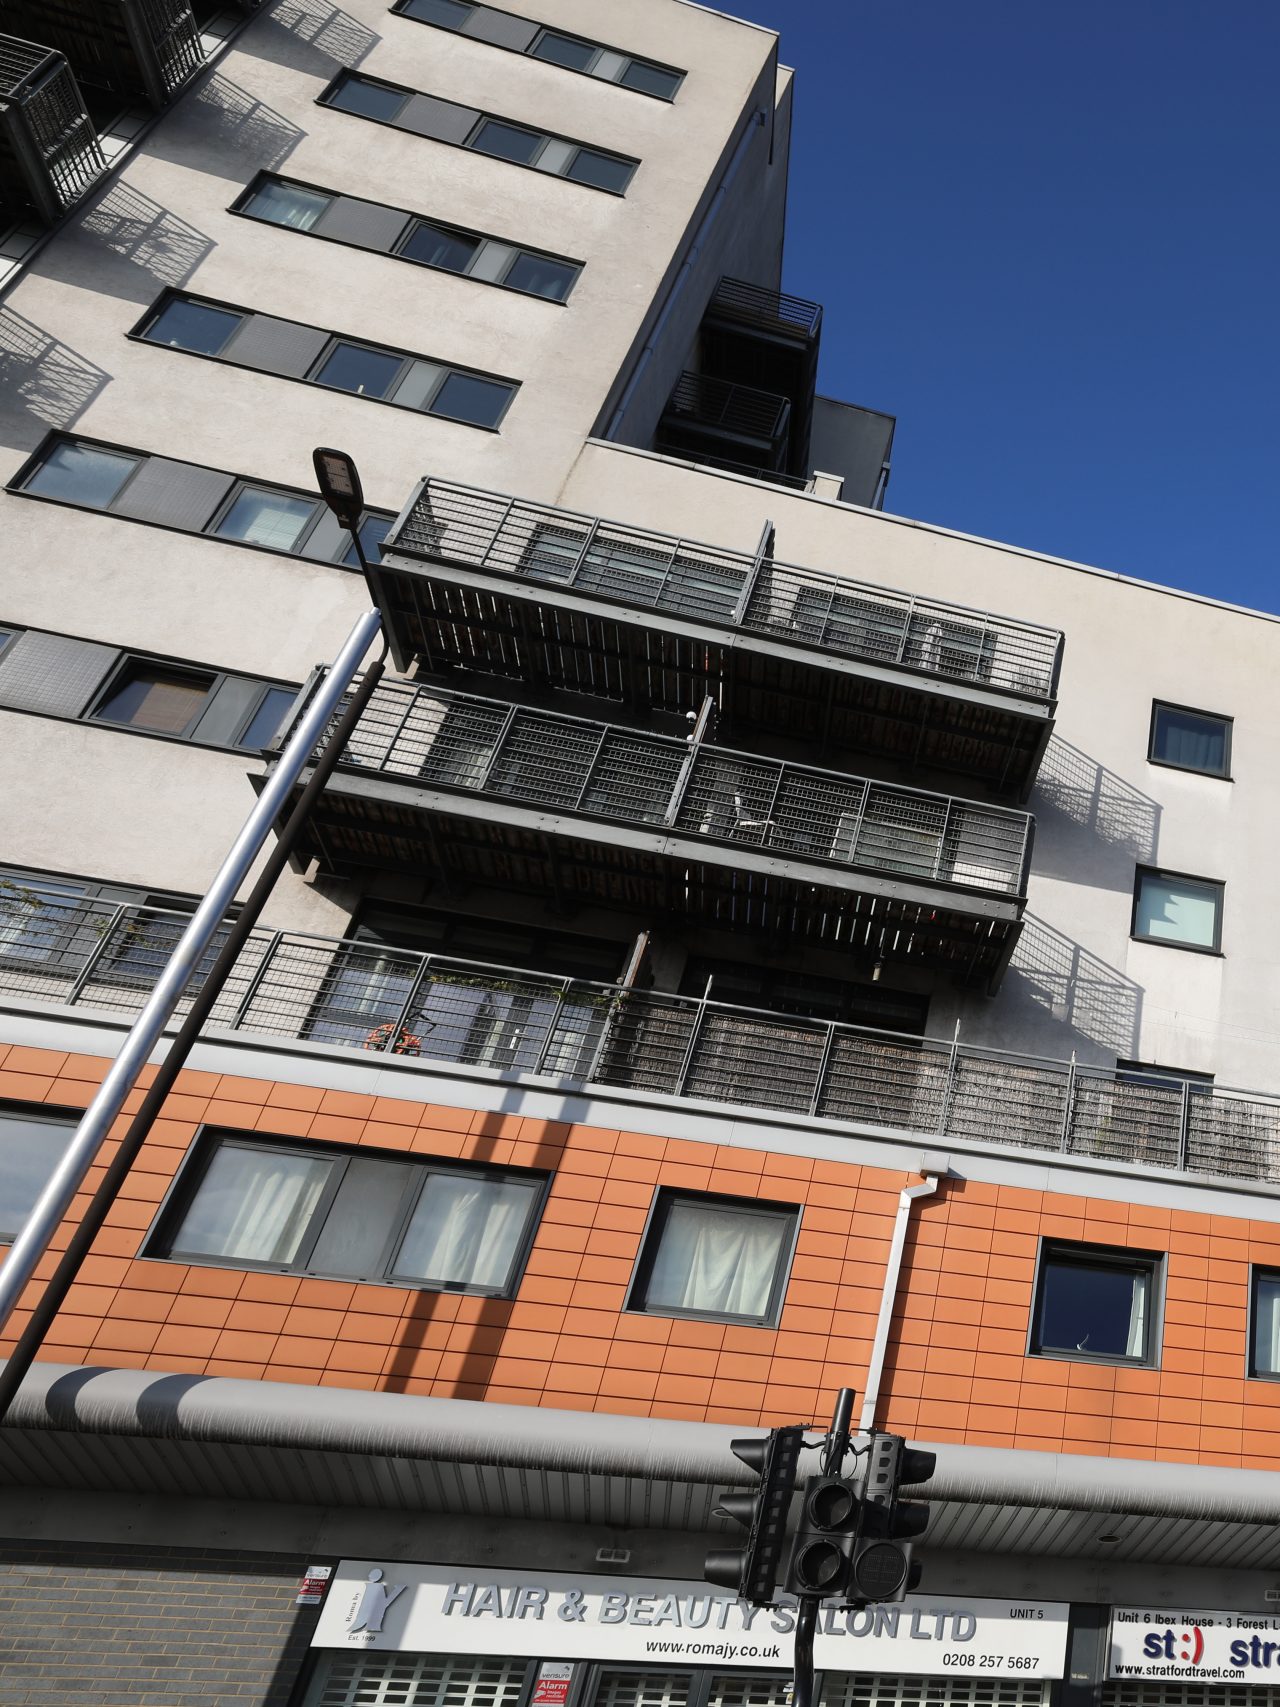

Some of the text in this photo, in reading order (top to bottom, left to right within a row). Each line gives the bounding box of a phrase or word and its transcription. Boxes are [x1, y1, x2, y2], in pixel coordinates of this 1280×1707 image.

[441, 1582, 549, 1620] HAIR
[557, 1588, 588, 1622] &
[598, 1591, 761, 1631] BEAUTY
[910, 1607, 977, 1642] LTD
[1010, 1608, 1044, 1619] UNIT 5
[1118, 1612, 1139, 1623] Unit
[1143, 1613, 1151, 1623] 6
[1155, 1613, 1176, 1625] Ibex
[1181, 1615, 1213, 1627] House
[1226, 1617, 1232, 1628] 3
[1236, 1618, 1268, 1630] Forest
[646, 1641, 780, 1659] www.romajy.co.uk
[942, 1653, 1040, 1669] 0208 257 5687
[1115, 1664, 1245, 1679] www.stratfordtravel.com
[538, 1681, 568, 1690] Alarm
